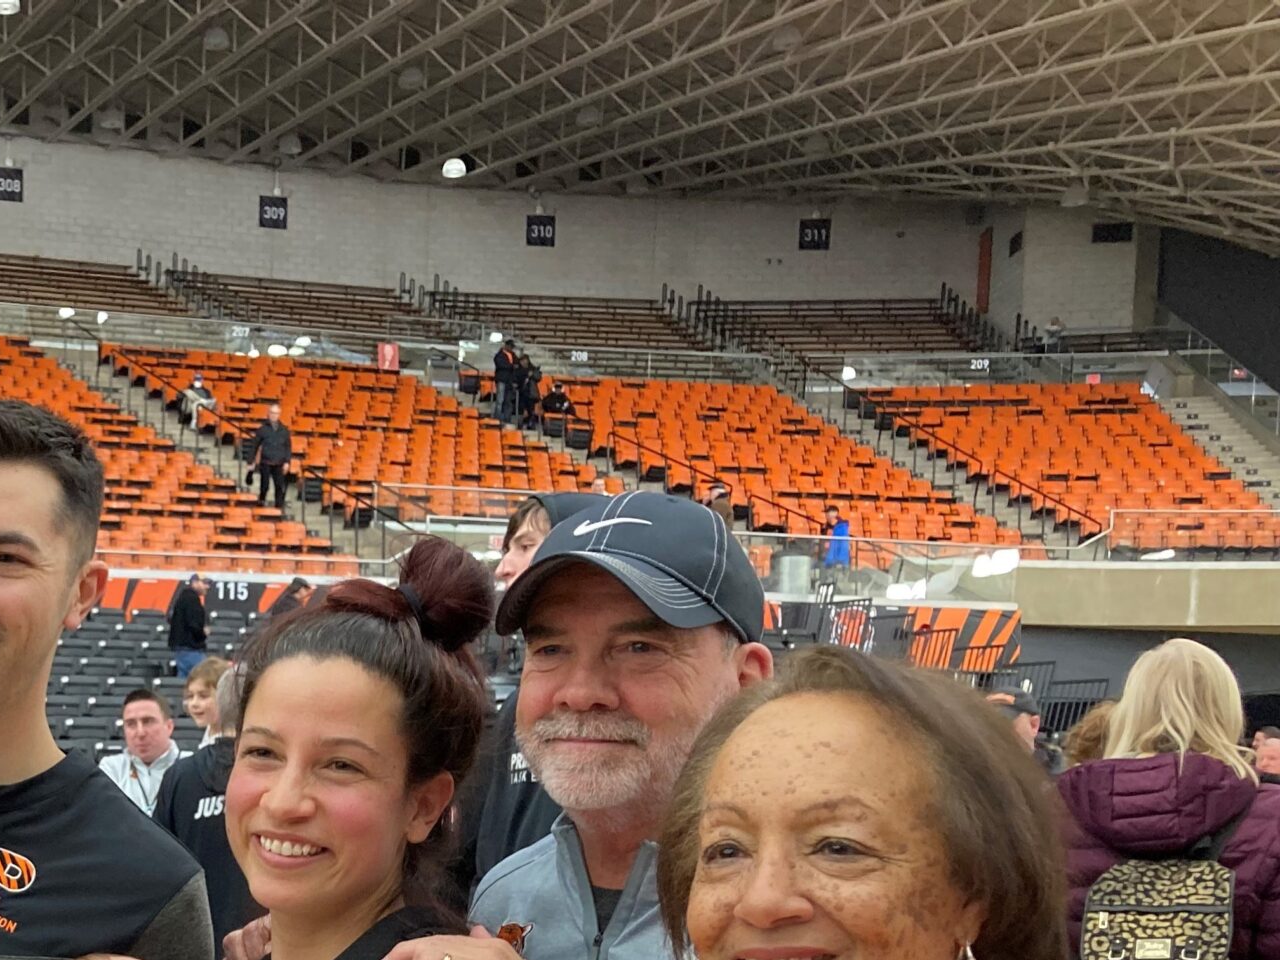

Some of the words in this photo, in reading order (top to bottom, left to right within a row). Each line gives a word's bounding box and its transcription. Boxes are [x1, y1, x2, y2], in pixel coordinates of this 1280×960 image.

[263, 205, 286, 221] 309
[531, 224, 553, 238] 310
[803, 228, 826, 241] 311
[231, 325, 250, 337] 207
[571, 350, 588, 361] 208
[970, 358, 990, 370] 209
[215, 581, 249, 601] 115
